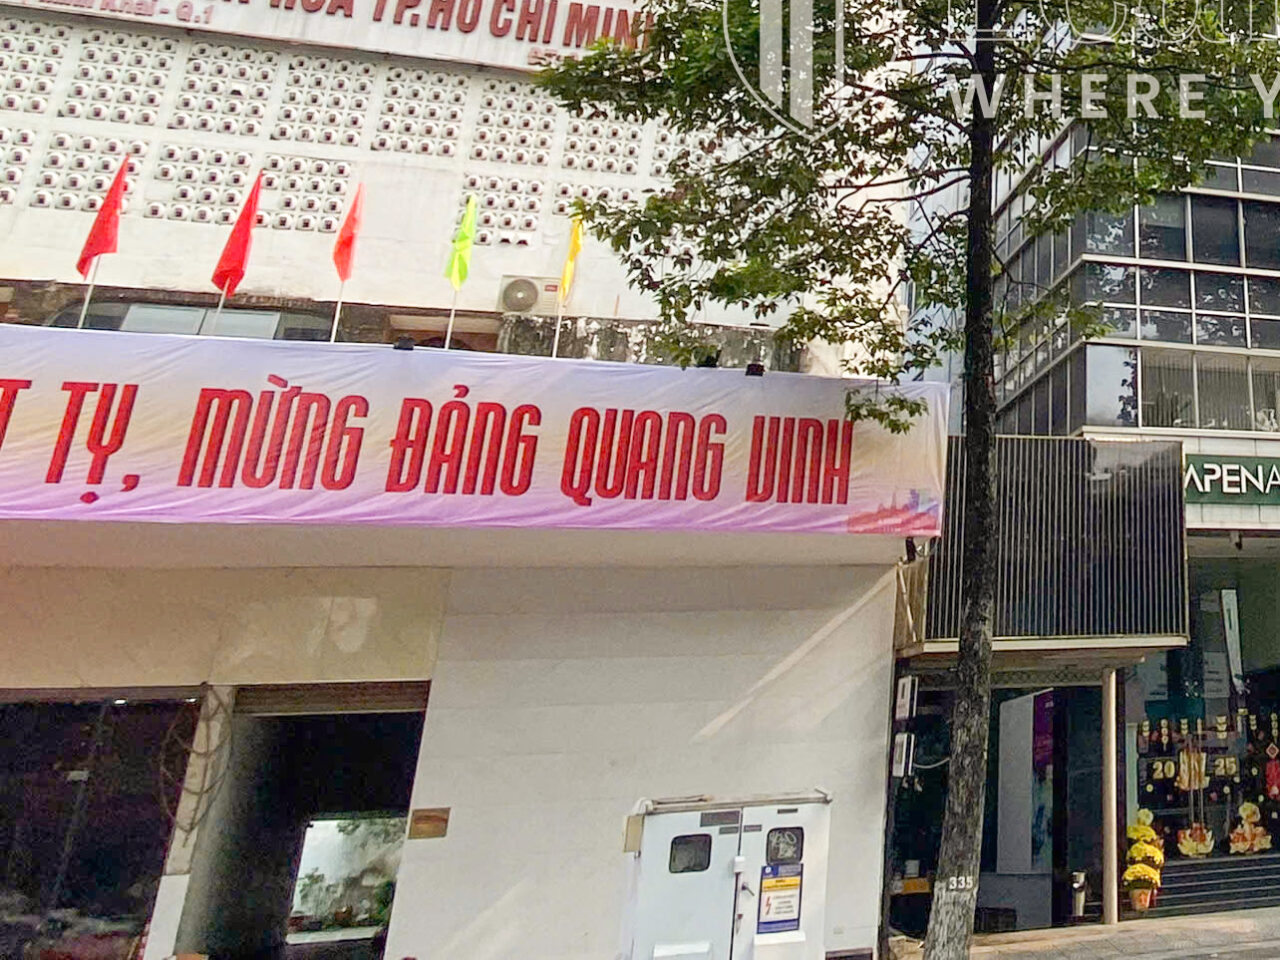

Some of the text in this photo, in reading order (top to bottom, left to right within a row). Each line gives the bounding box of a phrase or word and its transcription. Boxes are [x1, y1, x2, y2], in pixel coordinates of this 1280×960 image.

[176, 374, 370, 491] MỪNG
[385, 384, 542, 496] ĐẢNG
[561, 406, 728, 505] QUANG
[1153, 760, 1175, 779] 20
[949, 876, 974, 889] 335
